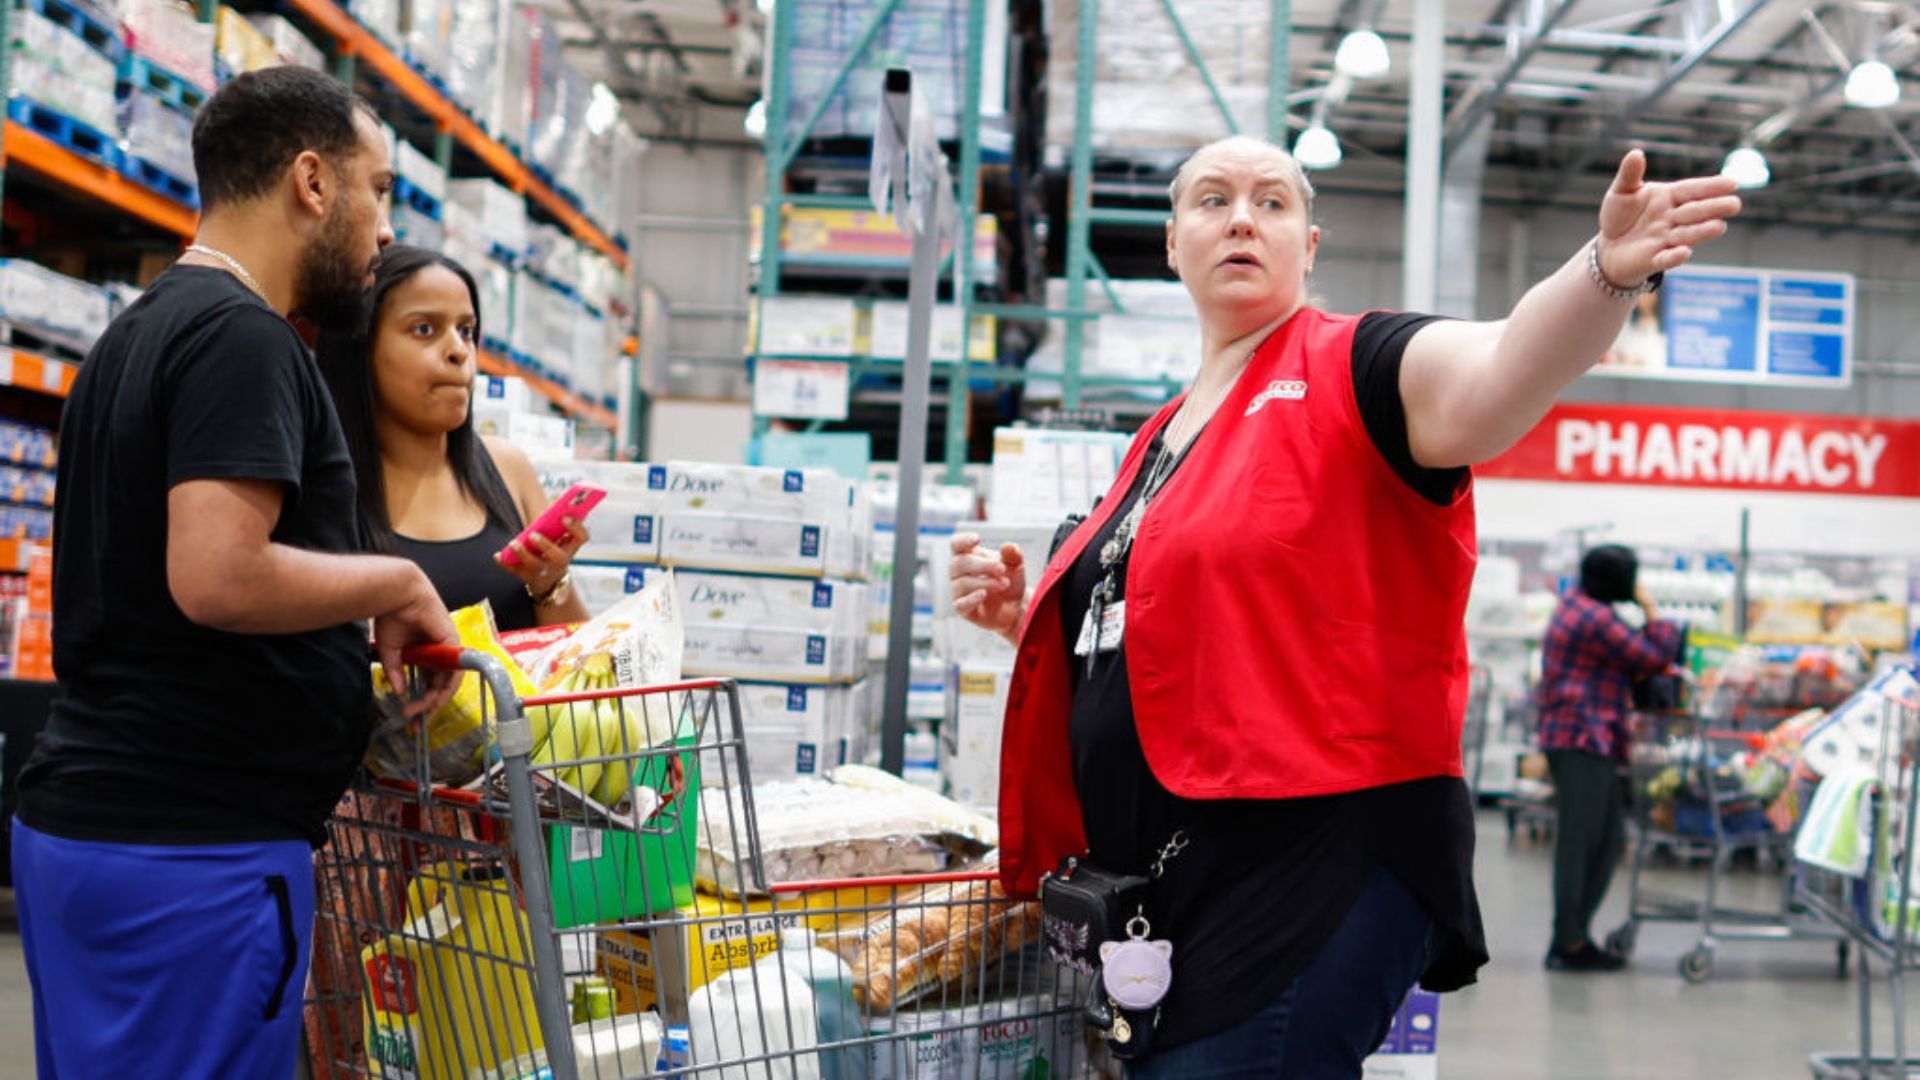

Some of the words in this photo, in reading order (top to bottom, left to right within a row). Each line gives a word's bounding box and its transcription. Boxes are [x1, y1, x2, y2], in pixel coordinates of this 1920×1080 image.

[1556, 418, 1887, 489] PHARMACY
[670, 473, 724, 492] Dove
[690, 581, 745, 605] Dove
[710, 915, 798, 940] EXTR-LAGE
